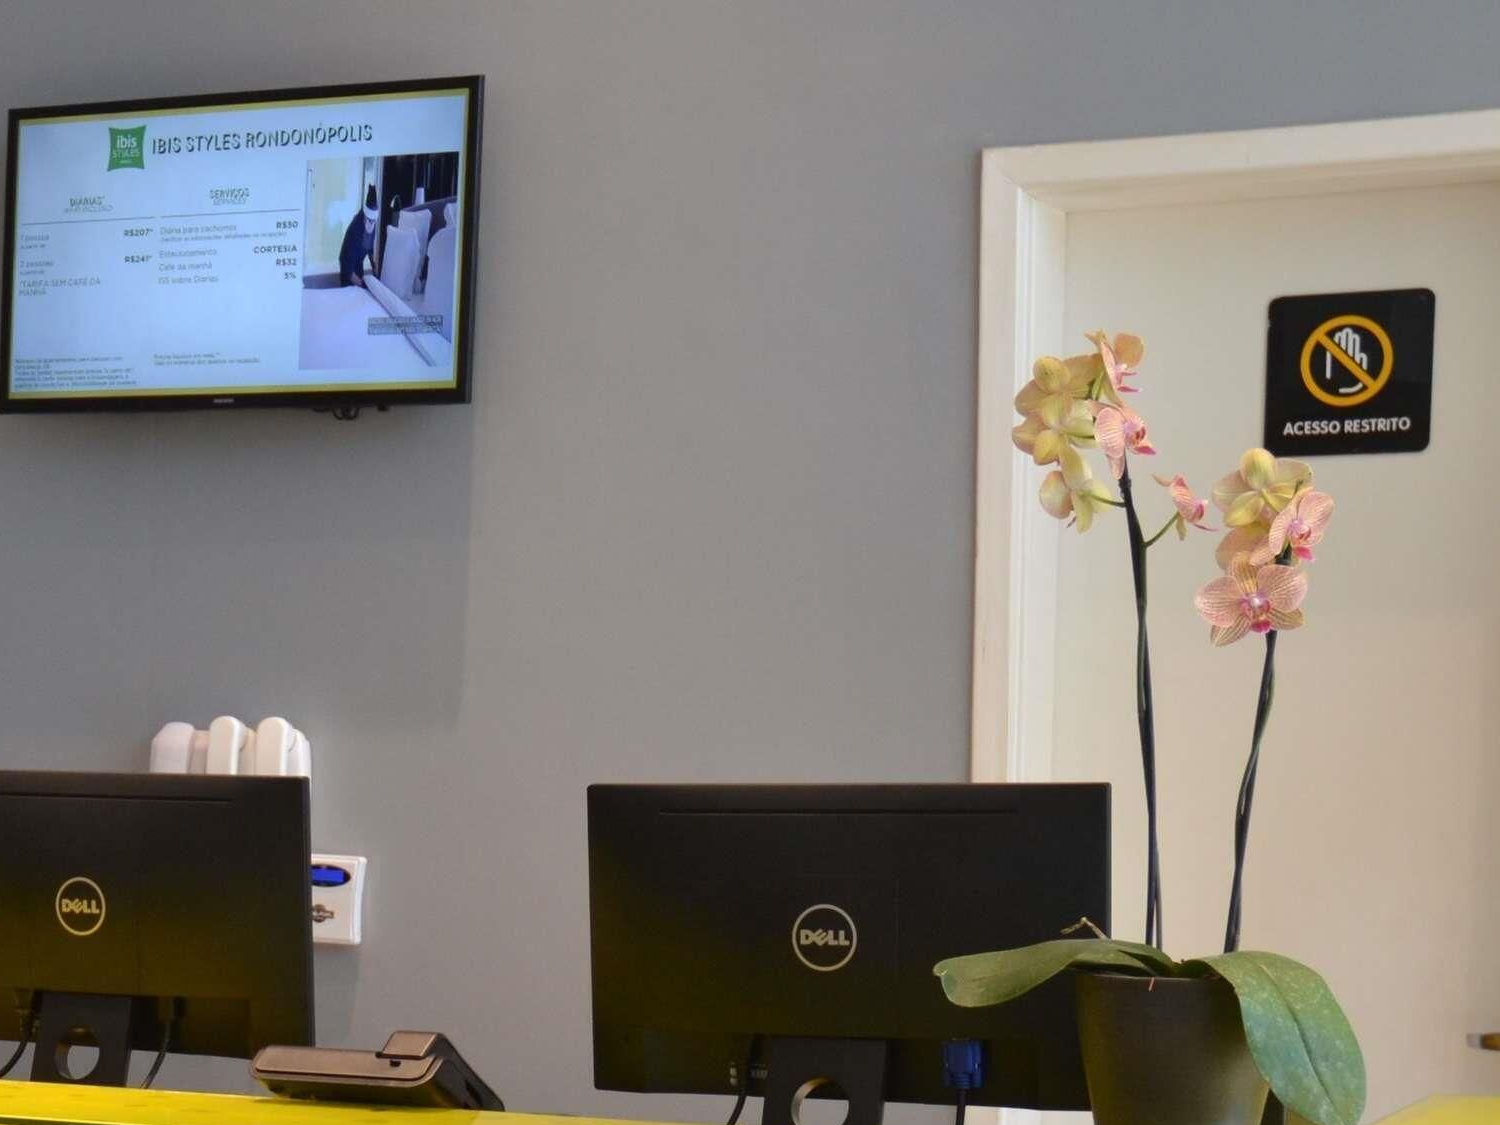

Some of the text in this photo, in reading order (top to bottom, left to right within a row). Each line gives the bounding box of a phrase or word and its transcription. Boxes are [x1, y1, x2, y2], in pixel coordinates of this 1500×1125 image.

[115, 134, 138, 149] ibis
[152, 121, 374, 155] IBIS STYLES RONDONÓPOLIS
[253, 244, 298, 255] CORTESIA
[275, 257, 298, 267] R$32
[1283, 416, 1411, 436] ACESSO RESTRITO
[61, 897, 100, 914] DELL
[800, 928, 850, 946] DELL
